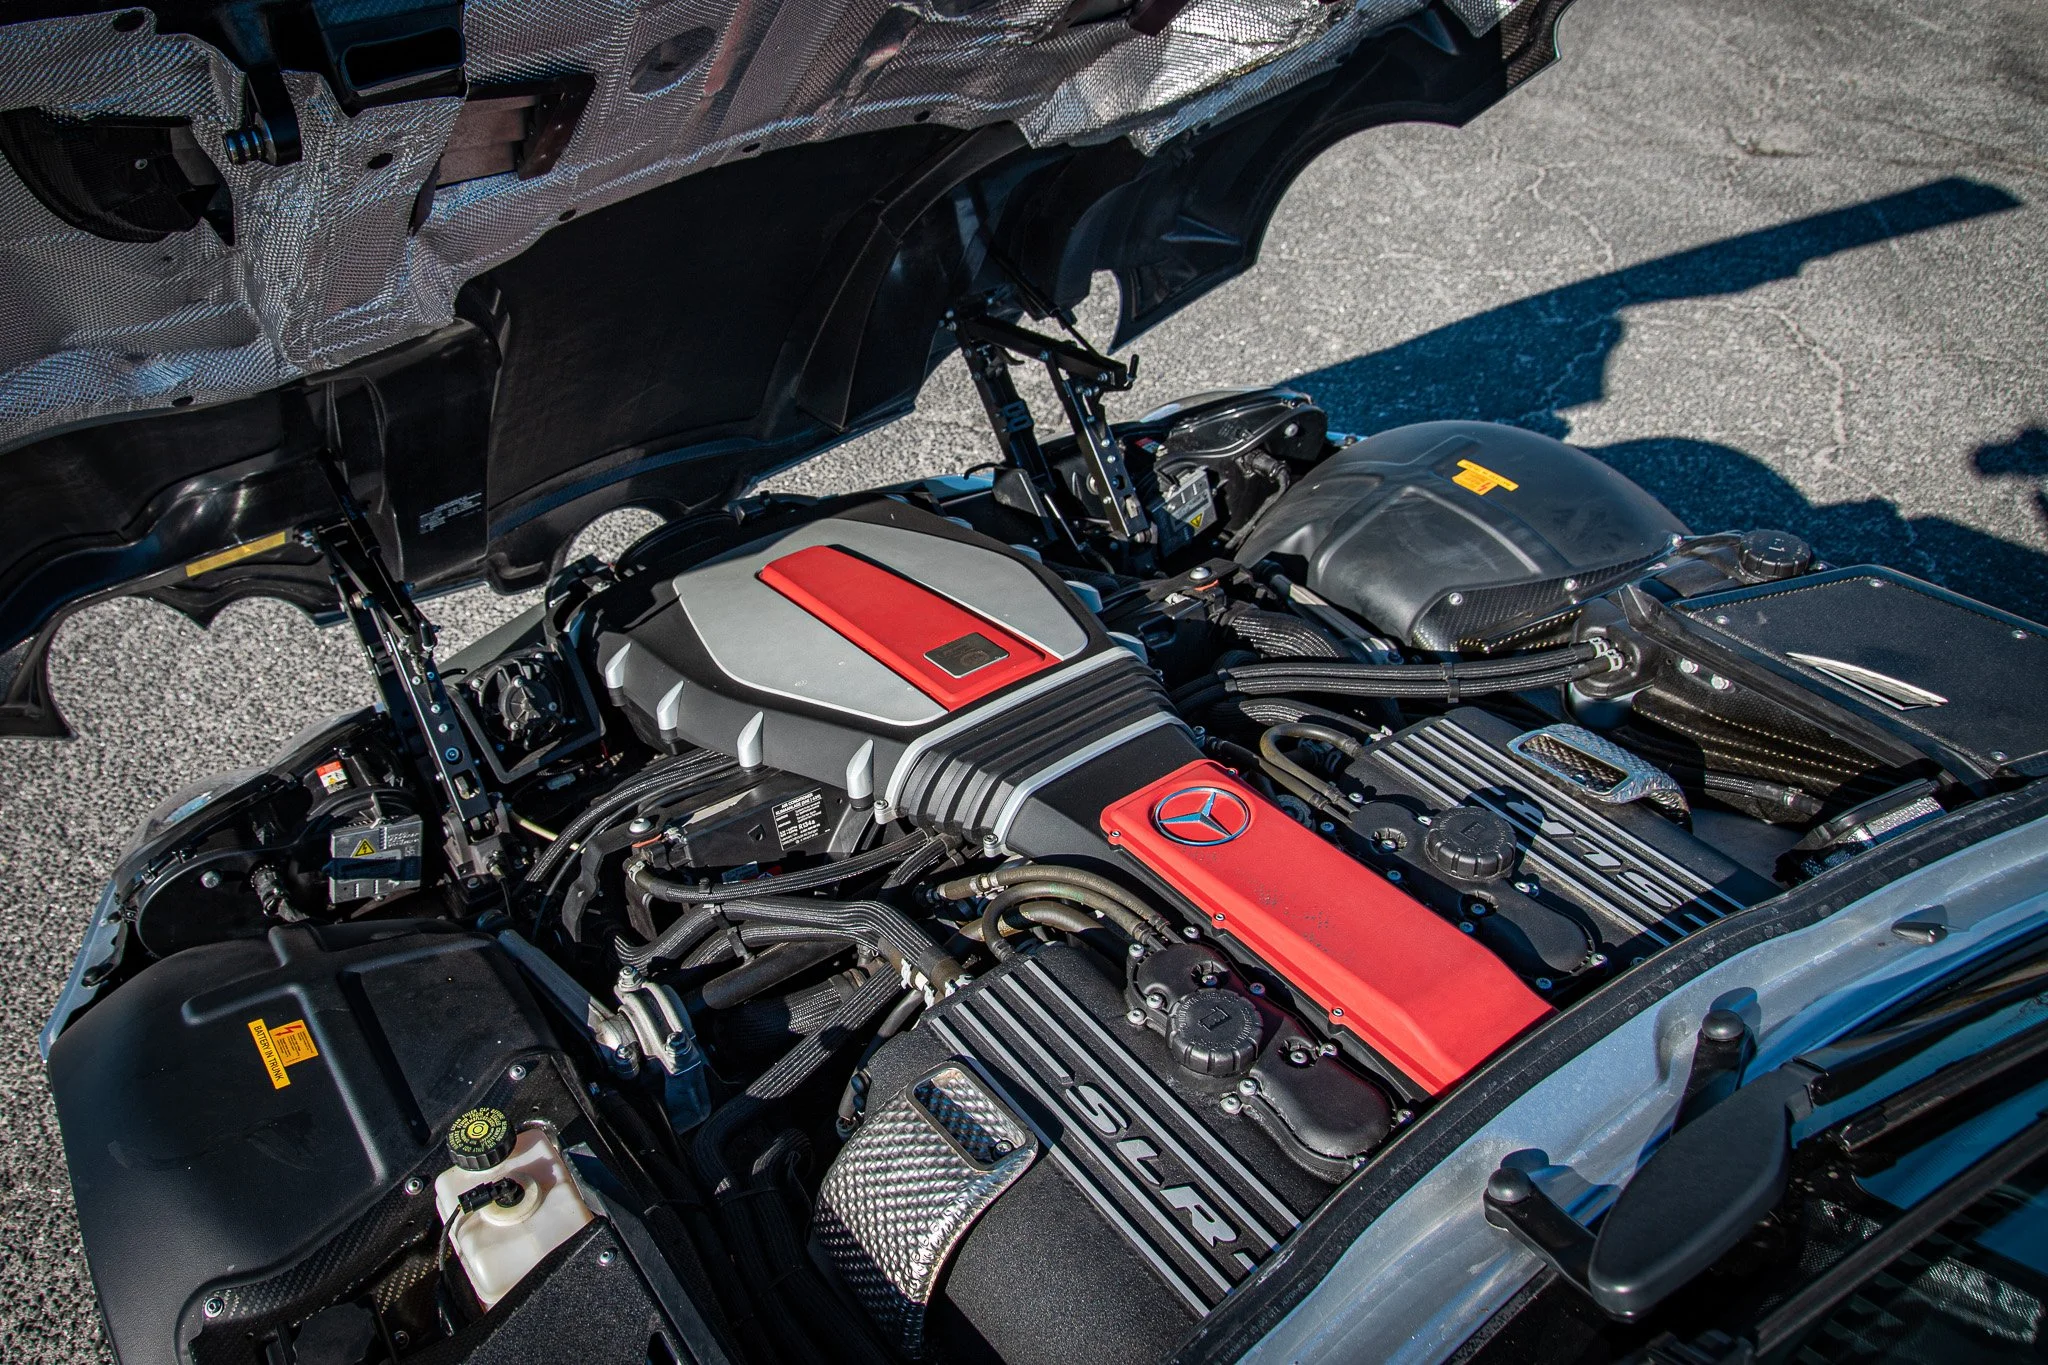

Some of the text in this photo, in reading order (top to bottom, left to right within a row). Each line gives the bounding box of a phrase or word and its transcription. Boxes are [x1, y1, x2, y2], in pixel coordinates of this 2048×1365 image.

[798, 820, 815, 829] R134a
[254, 1025, 284, 1081] BATTERY IN TRUNK
[1065, 1085, 1237, 1247] SLR
